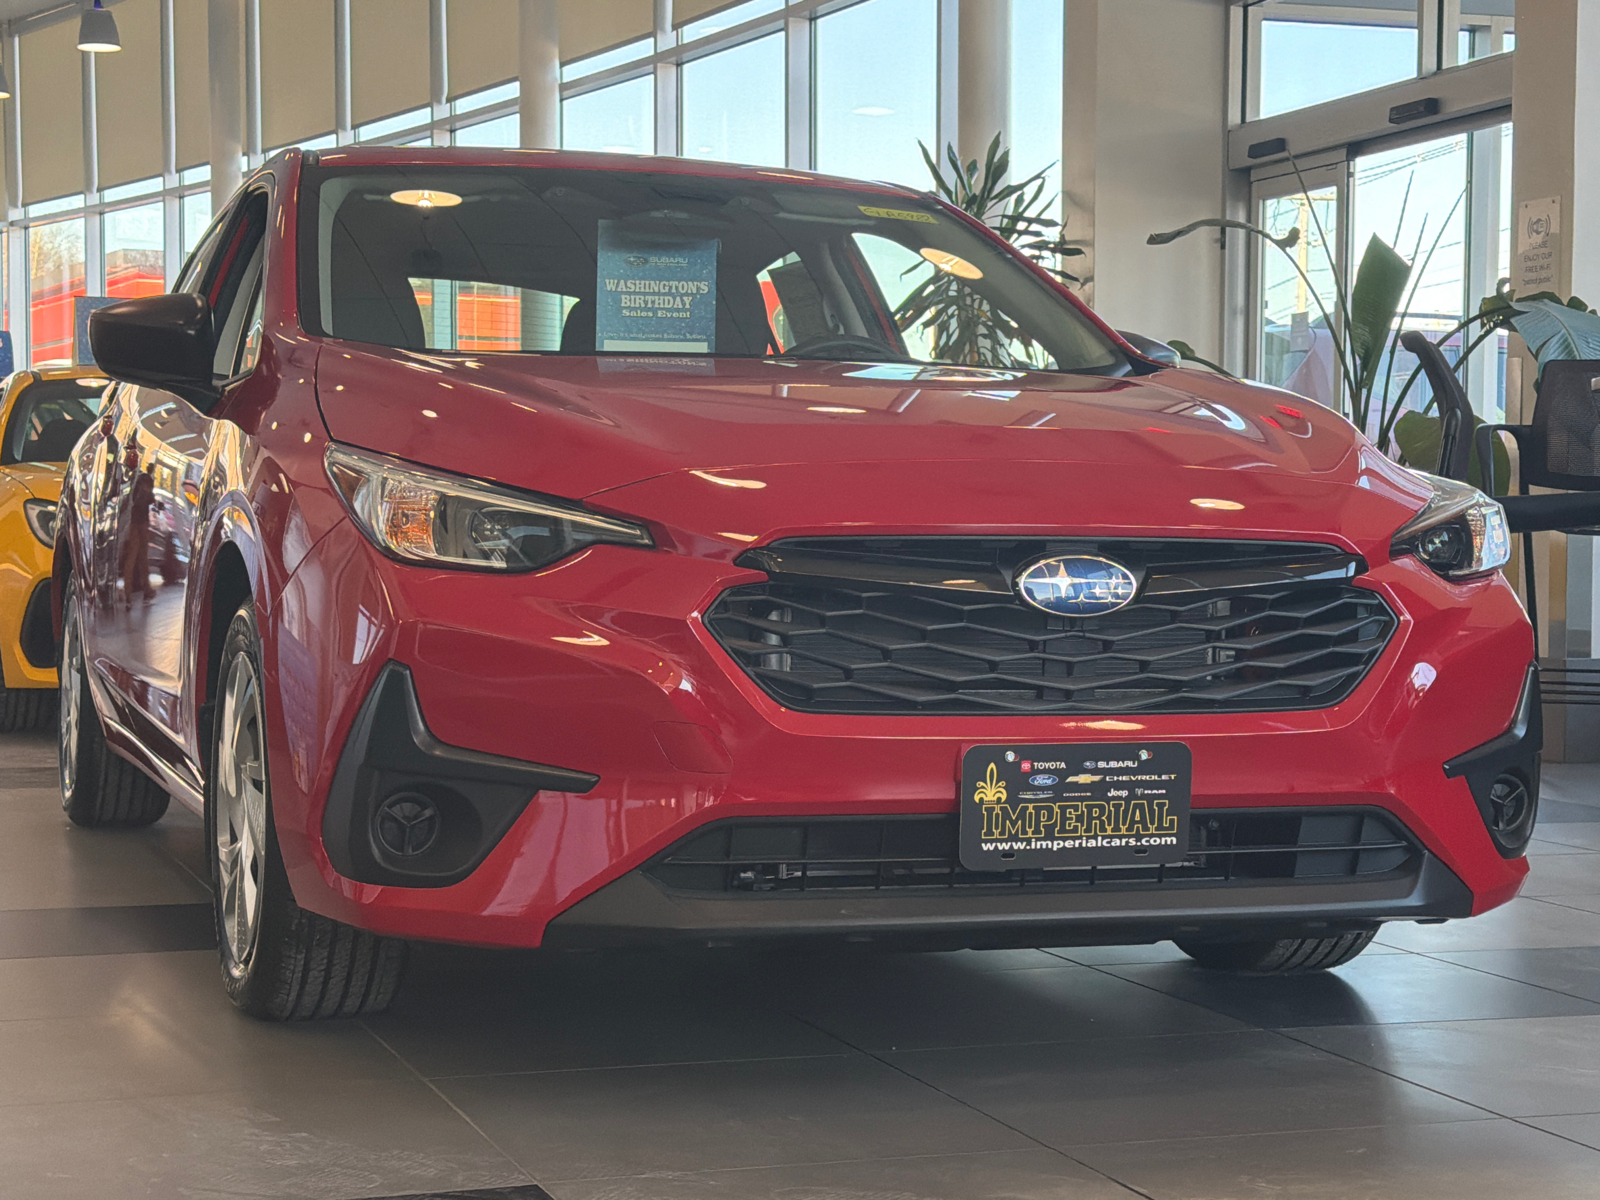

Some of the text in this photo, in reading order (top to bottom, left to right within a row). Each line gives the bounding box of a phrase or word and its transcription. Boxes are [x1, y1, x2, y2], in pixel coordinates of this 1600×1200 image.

[1529, 240, 1549, 249] PLEASE
[650, 256, 689, 264] SUBARU
[1523, 251, 1552, 262] ENJOY OUR
[1525, 265, 1538, 273] FREE
[604, 279, 709, 294] WASHINGTON'S
[620, 295, 693, 309] BIRTHDAY
[622, 309, 691, 318] Sales Event
[1033, 761, 1067, 770] TOYOTA
[1097, 760, 1138, 768] SUBARU
[1033, 775, 1054, 786] Ford
[1105, 774, 1177, 782] CHEVROLET
[1107, 788, 1129, 798] Jeep
[981, 800, 1178, 839] IMPERIAL
[981, 835, 1177, 851] www.imperialcars.com
